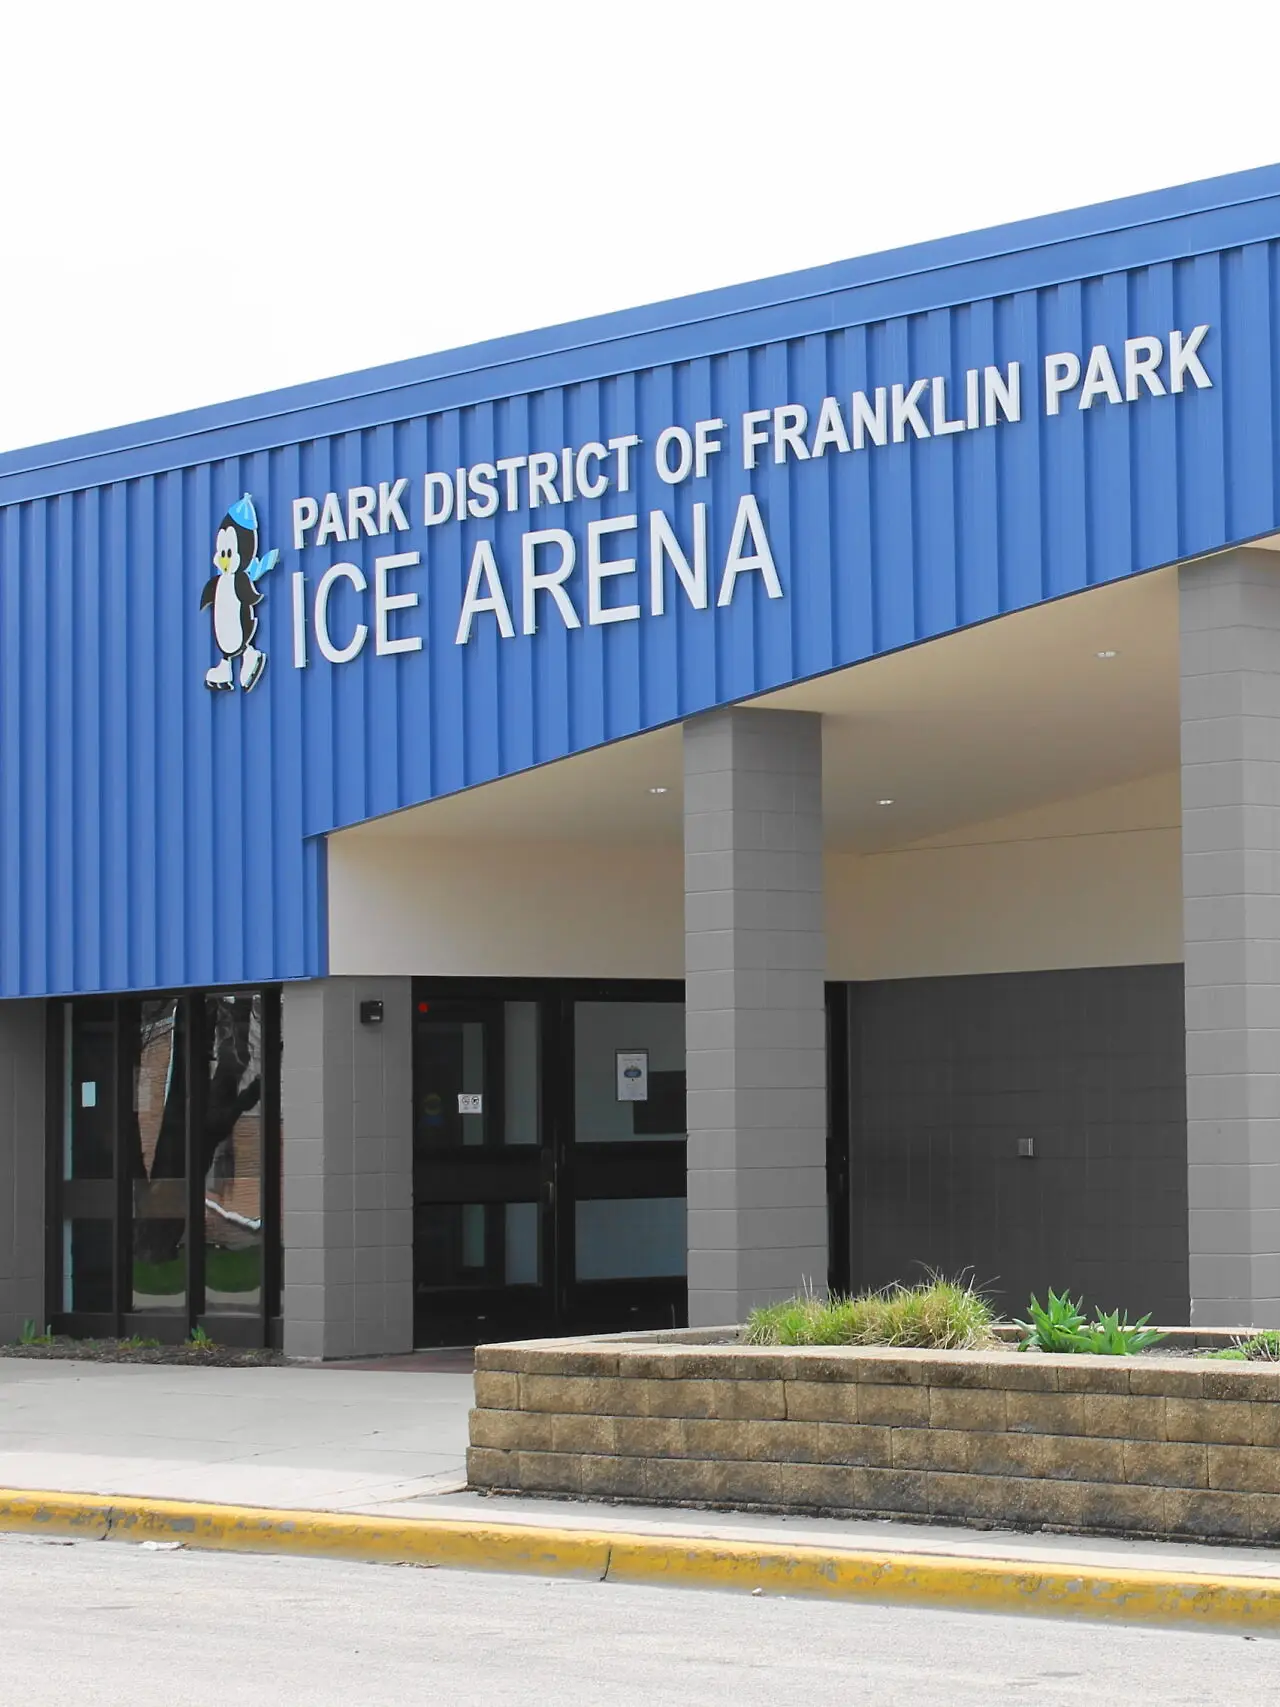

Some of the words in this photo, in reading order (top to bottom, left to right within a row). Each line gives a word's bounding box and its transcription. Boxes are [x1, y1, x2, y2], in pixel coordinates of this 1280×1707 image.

[290, 492, 407, 549] PARK
[423, 435, 642, 526] DISTRICT
[655, 418, 727, 484] OF
[742, 361, 1020, 471] FRANKLIN
[1045, 323, 1214, 416] PARK
[291, 552, 424, 668] ICE
[455, 494, 783, 644] ARENA
